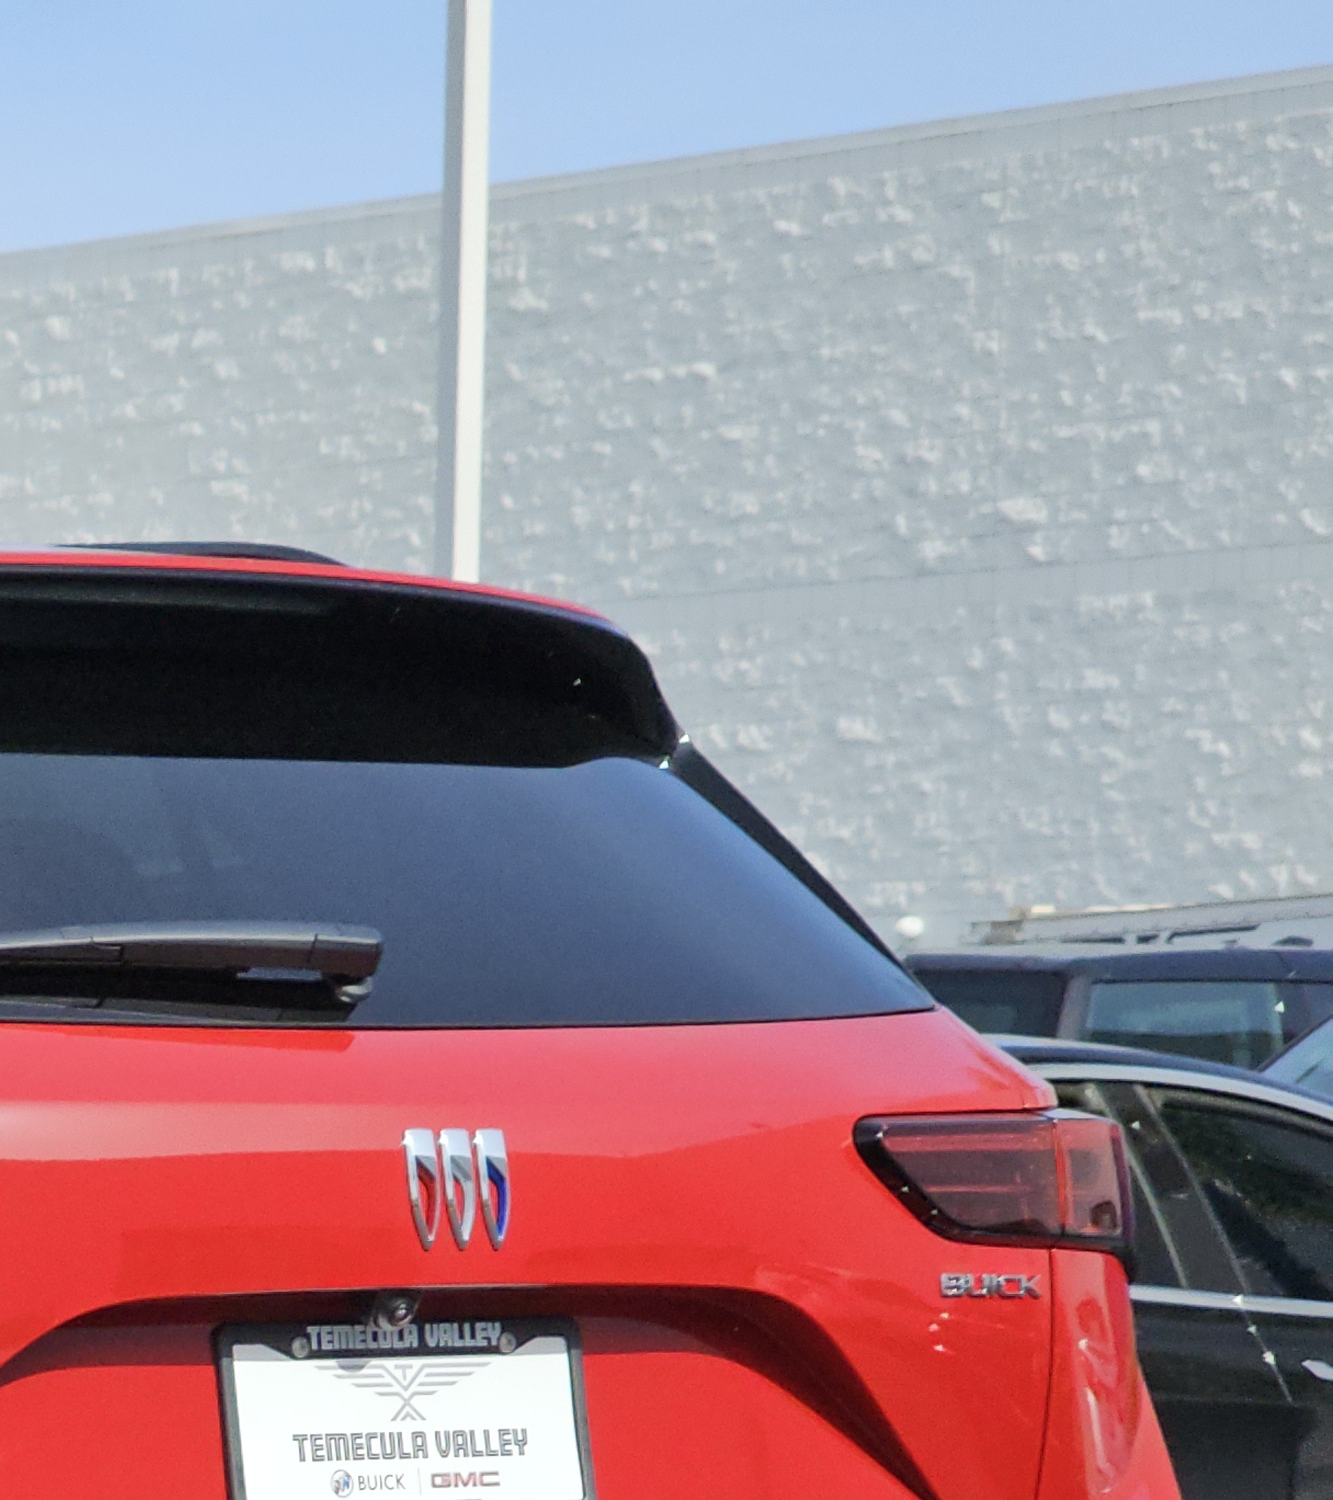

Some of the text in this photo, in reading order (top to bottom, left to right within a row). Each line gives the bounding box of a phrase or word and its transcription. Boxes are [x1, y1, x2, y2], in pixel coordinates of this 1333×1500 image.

[940, 1273, 1042, 1298] BUICK
[307, 1321, 502, 1350] TEMECULA VALLEY
[292, 1428, 528, 1462] TEMECULA VALLEY
[357, 1471, 501, 1491] BUICK GMC
